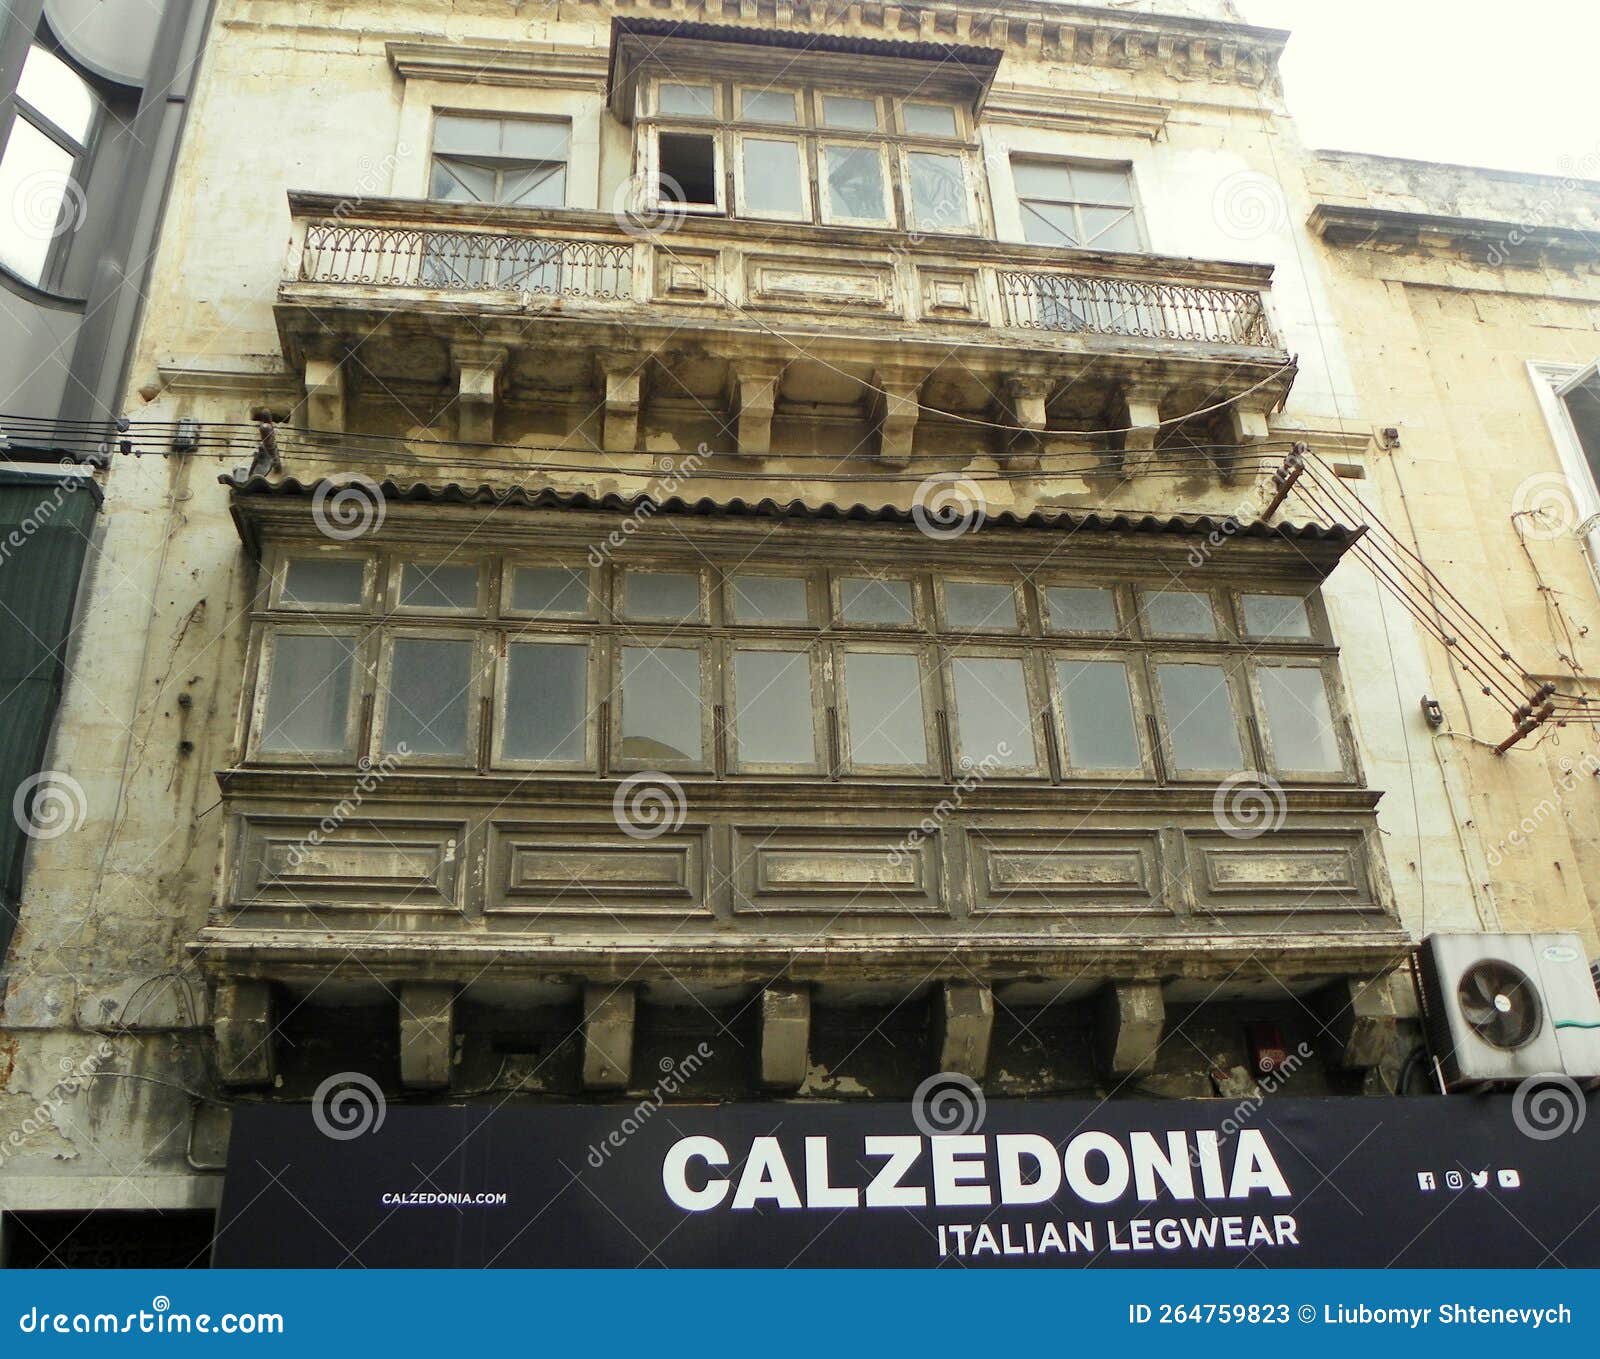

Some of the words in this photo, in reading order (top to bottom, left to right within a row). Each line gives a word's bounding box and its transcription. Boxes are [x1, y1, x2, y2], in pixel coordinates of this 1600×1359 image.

[662, 1129, 1292, 1212] CALZEDONIA
[381, 1192, 507, 1205] CALZEDONIA.COM
[937, 1221, 1095, 1256] ITALIAN
[1108, 1215, 1299, 1252] LEGWEAR
